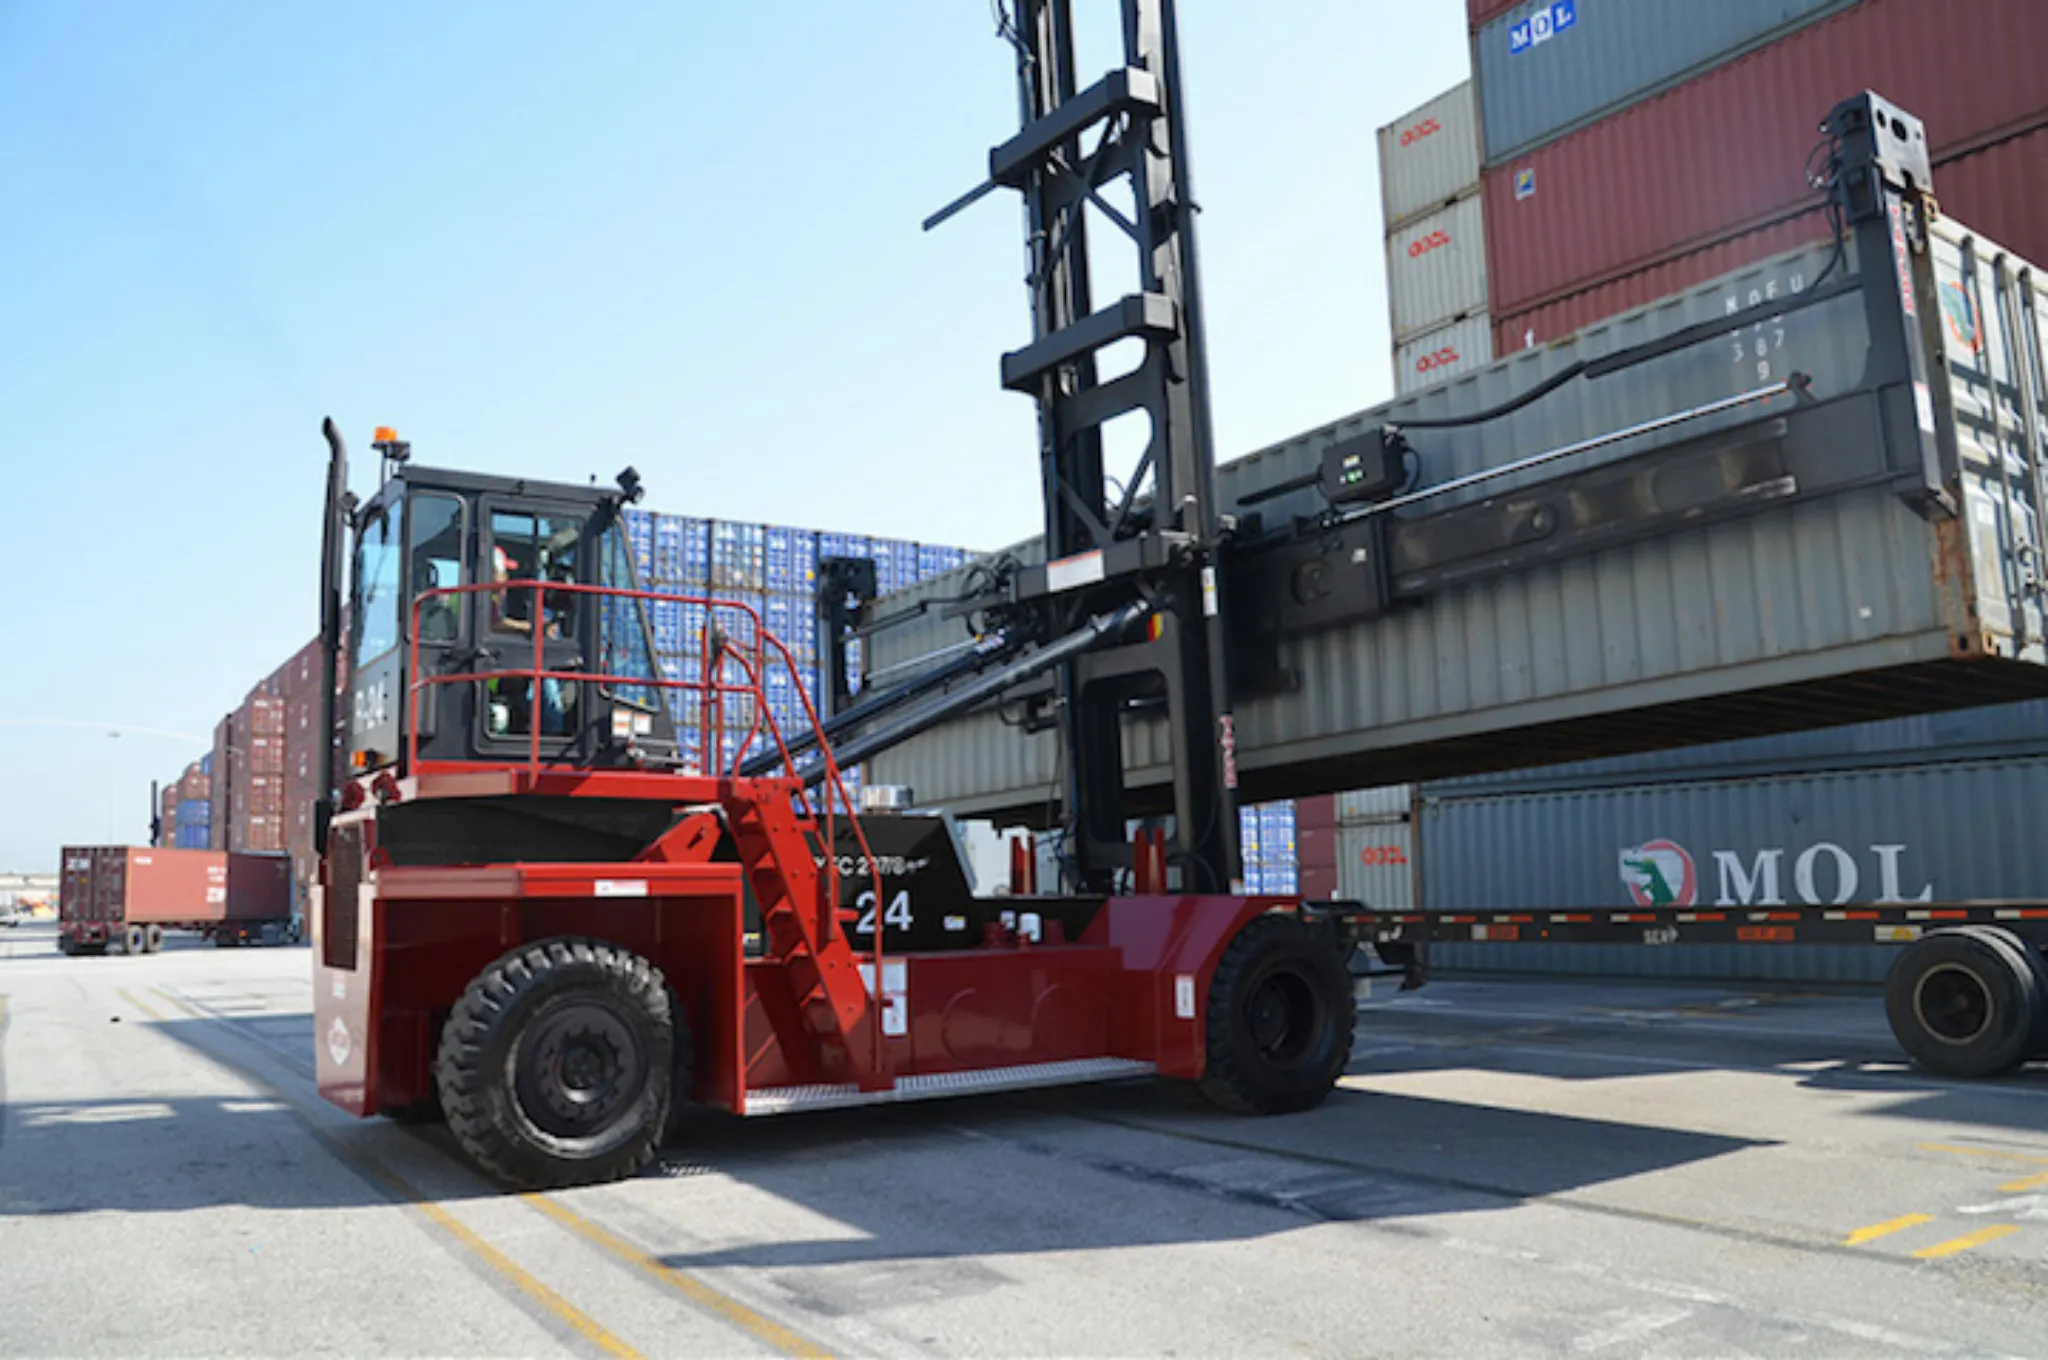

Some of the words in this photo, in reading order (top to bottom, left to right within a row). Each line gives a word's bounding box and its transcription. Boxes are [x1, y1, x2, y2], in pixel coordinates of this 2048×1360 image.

[1511, 3, 1575, 51] MOL
[1399, 117, 1442, 148] OOCL
[1409, 229, 1452, 258] OOCL
[1416, 346, 1460, 373] OOCL
[1361, 845, 1408, 867] OOCL
[1712, 842, 1933, 906] MOL
[856, 890, 914, 934] 24
